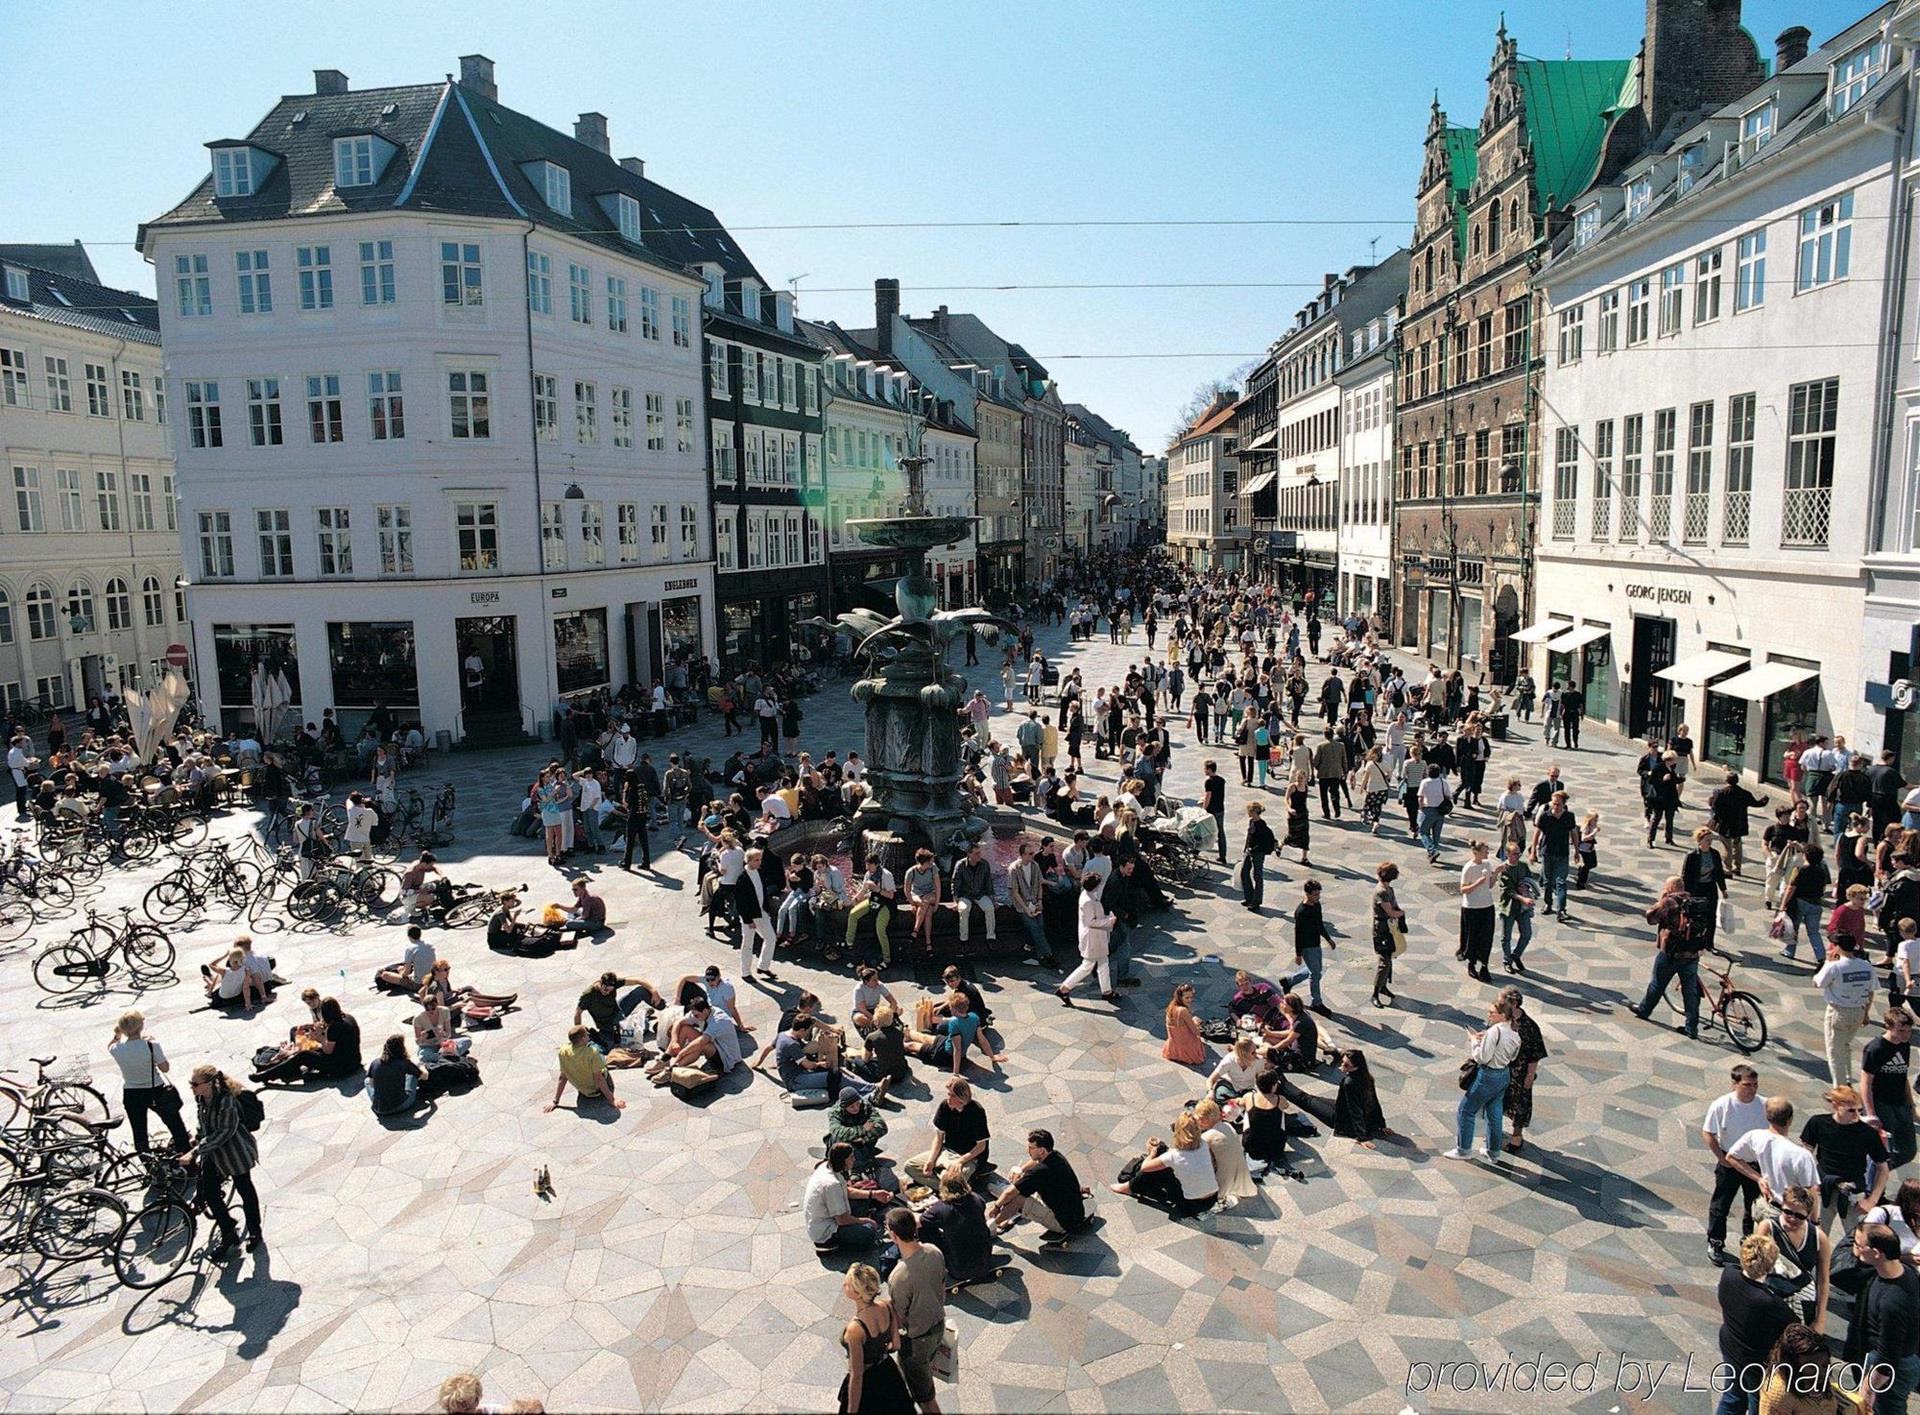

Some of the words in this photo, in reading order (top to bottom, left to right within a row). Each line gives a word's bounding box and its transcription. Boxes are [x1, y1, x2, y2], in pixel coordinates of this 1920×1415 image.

[471, 592, 500, 602] EUROPA
[1625, 584, 1655, 600] GEORG
[1657, 587, 1691, 604] JENSEN
